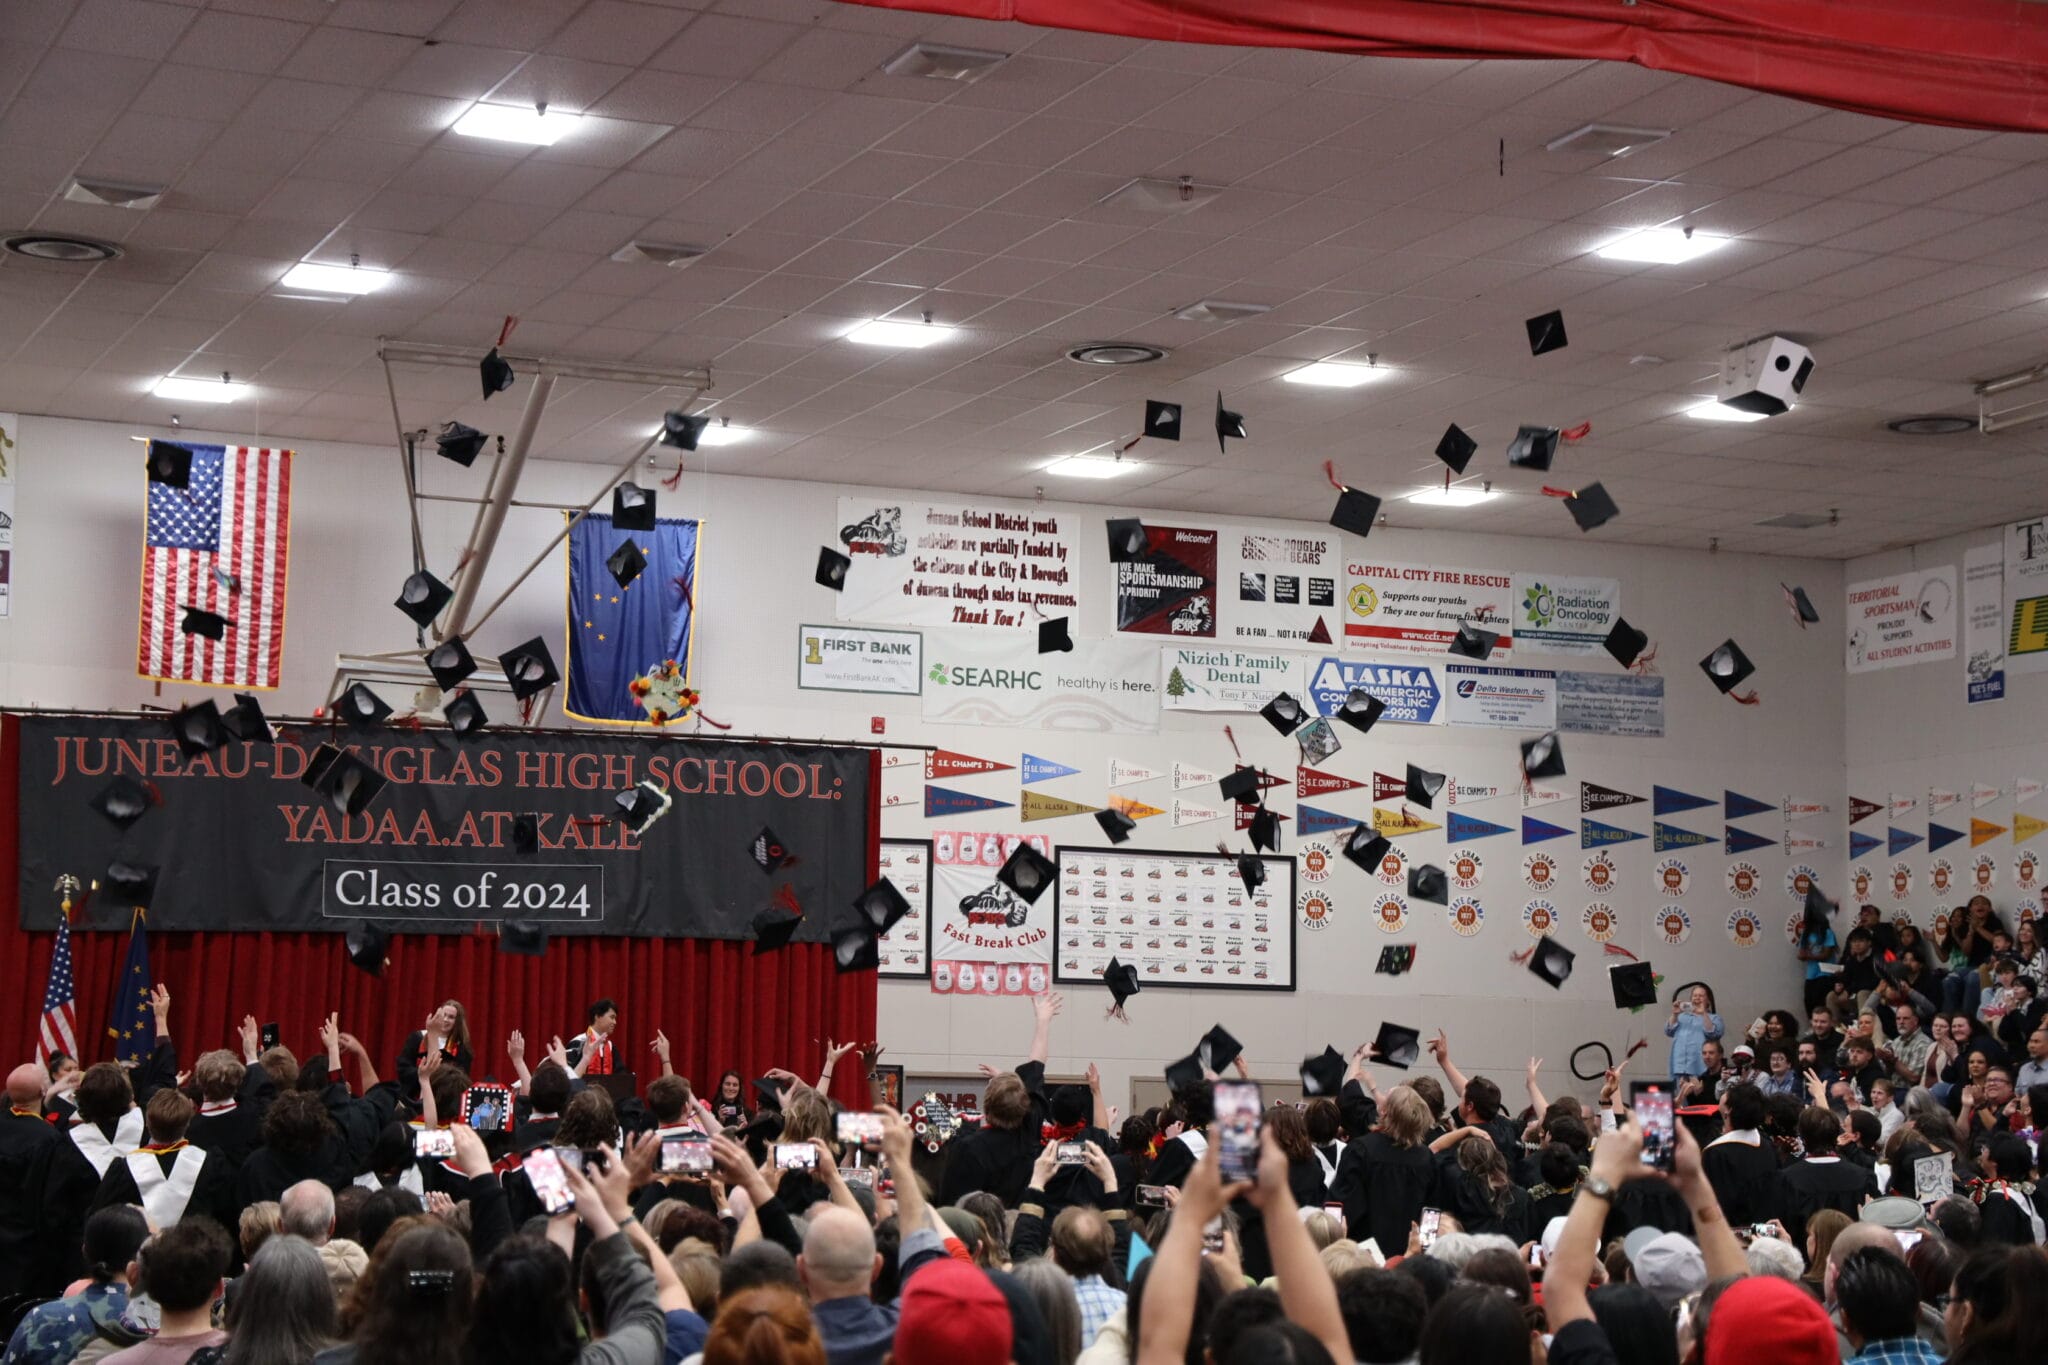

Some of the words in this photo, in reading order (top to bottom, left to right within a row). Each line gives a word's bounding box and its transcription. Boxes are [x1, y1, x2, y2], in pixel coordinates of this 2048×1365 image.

[962, 510, 992, 529] School
[994, 513, 1029, 532] District
[1032, 517, 1058, 537] youth
[1175, 530, 1214, 545] Welcome!
[961, 539, 977, 552] are
[980, 537, 1019, 559] partially
[1022, 539, 1054, 558] funded
[1056, 541, 1068, 563] by
[913, 555, 928, 572] the
[968, 559, 979, 576] of
[981, 560, 996, 577] the
[999, 561, 1017, 583] City
[1020, 562, 1028, 580] &
[1031, 563, 1069, 587] Borough
[1119, 562, 1133, 573] WE
[1133, 563, 1156, 574] MAKE
[1347, 564, 1401, 580] CAPITAL
[1402, 567, 1430, 582] CITY
[1433, 570, 1461, 584] FIRE
[1463, 573, 1511, 588] RESCUE
[1119, 571, 1204, 588] SPORTSMANSHIP
[902, 578, 914, 596] of
[953, 582, 989, 604] through
[992, 585, 1014, 602] sales
[1017, 587, 1032, 604] tax
[1034, 592, 1077, 607] revenues.
[1119, 586, 1125, 597] A
[1126, 587, 1161, 599] PRIORITY
[1382, 591, 1420, 604] Supports
[1422, 595, 1437, 604] our
[1438, 594, 1467, 607] youths
[1848, 584, 1901, 605] TERRITORIAL
[1556, 595, 1610, 609] Radiation
[951, 605, 989, 625] Thank
[993, 608, 1015, 627] You
[1382, 606, 1403, 617] They
[1404, 609, 1418, 617] are
[1436, 610, 1462, 620] future
[1556, 608, 1610, 625] Oncology
[1236, 626, 1245, 636] BE
[1246, 627, 1251, 636] A
[1253, 628, 1267, 637] FAN
[1277, 629, 1291, 639] NOT
[1292, 630, 1297, 639] A
[1877, 619, 1906, 631] PROUDLY
[1401, 631, 1455, 643] www.ccfr.net
[1882, 629, 1914, 643] SUPPORTS
[823, 638, 866, 652] FIRST
[870, 641, 912, 655] BANK
[1350, 640, 1379, 649] Accepting
[1380, 642, 1408, 651] Volunteer
[1409, 644, 1446, 654] Applications
[1867, 650, 1879, 662] ALL
[1879, 645, 1913, 658] STUDENT
[1913, 638, 1953, 654] ACTIVITIES
[1178, 650, 1229, 668] Nizich
[1235, 652, 1290, 673] Family
[951, 666, 1042, 691] SEARHC
[1057, 676, 1105, 692] healthy
[1109, 680, 1119, 690] is
[1121, 679, 1156, 693] here.
[1207, 668, 1261, 685] Dental
[1315, 657, 1430, 691] ALASKA
[1219, 689, 1239, 701] Tony
[1476, 684, 1498, 693] Delta
[52, 736, 503, 787] JUNEAU-DUGLAS
[515, 751, 636, 790] HIGH
[646, 756, 843, 801] SCHOOL:
[951, 760, 983, 769] CHAMPS
[1039, 765, 1057, 774] CHAMPS
[1126, 769, 1144, 777] CHAMPS
[1298, 769, 1307, 796] WHS
[1318, 778, 1341, 788] CHAMPS
[1342, 780, 1351, 789] 75
[1466, 787, 1488, 796] CHAMPS
[1488, 787, 1497, 796] 77
[1582, 784, 1591, 811] KHS
[1600, 793, 1624, 803] CHAMPS
[951, 799, 977, 807] ALASKA
[1044, 803, 1069, 811] ALASKA
[1180, 809, 1193, 817] STATE
[1193, 810, 1212, 818] CHAMPS
[1312, 842, 1333, 860] CHAMP
[1461, 849, 1483, 867] CHAMP
[1536, 852, 1557, 870] CHAMP
[1595, 855, 1617, 873] CHAMP
[1668, 858, 1690, 877] CHAMP
[1301, 868, 1329, 881] JUNEAU
[1377, 871, 1405, 885] JUNEAU
[1739, 862, 1760, 880] CHAMP
[1451, 876, 1479, 888] JUNEAU
[1525, 876, 1556, 891] KETCHIKAN
[1584, 878, 1615, 894] KETCHIKAN
[335, 868, 442, 908] Class
[453, 871, 497, 909] of
[502, 883, 591, 917] 2024
[1661, 885, 1684, 897] SITKA
[1297, 890, 1314, 911] STATE
[1315, 889, 1334, 913] CHAMP
[1373, 893, 1389, 914] STATE
[1390, 893, 1409, 915] CHAMP
[1448, 896, 1464, 917] STATE
[1466, 896, 1485, 919] CHAMP
[1523, 899, 1539, 921] STATE
[1540, 899, 1559, 923] CHAMP
[1582, 903, 1598, 924] STATE
[1600, 903, 1618, 926] CHAMP
[1656, 906, 1672, 926] STATE
[1673, 906, 1691, 929] CHAMP
[1303, 916, 1329, 929] VALDEZ
[1728, 909, 1743, 930] STATE
[1743, 909, 1762, 932] CHAMP
[943, 922, 970, 944] Fast
[974, 935, 1013, 949] Break
[1017, 927, 1048, 947] Club
[1664, 933, 1682, 945] EAST
